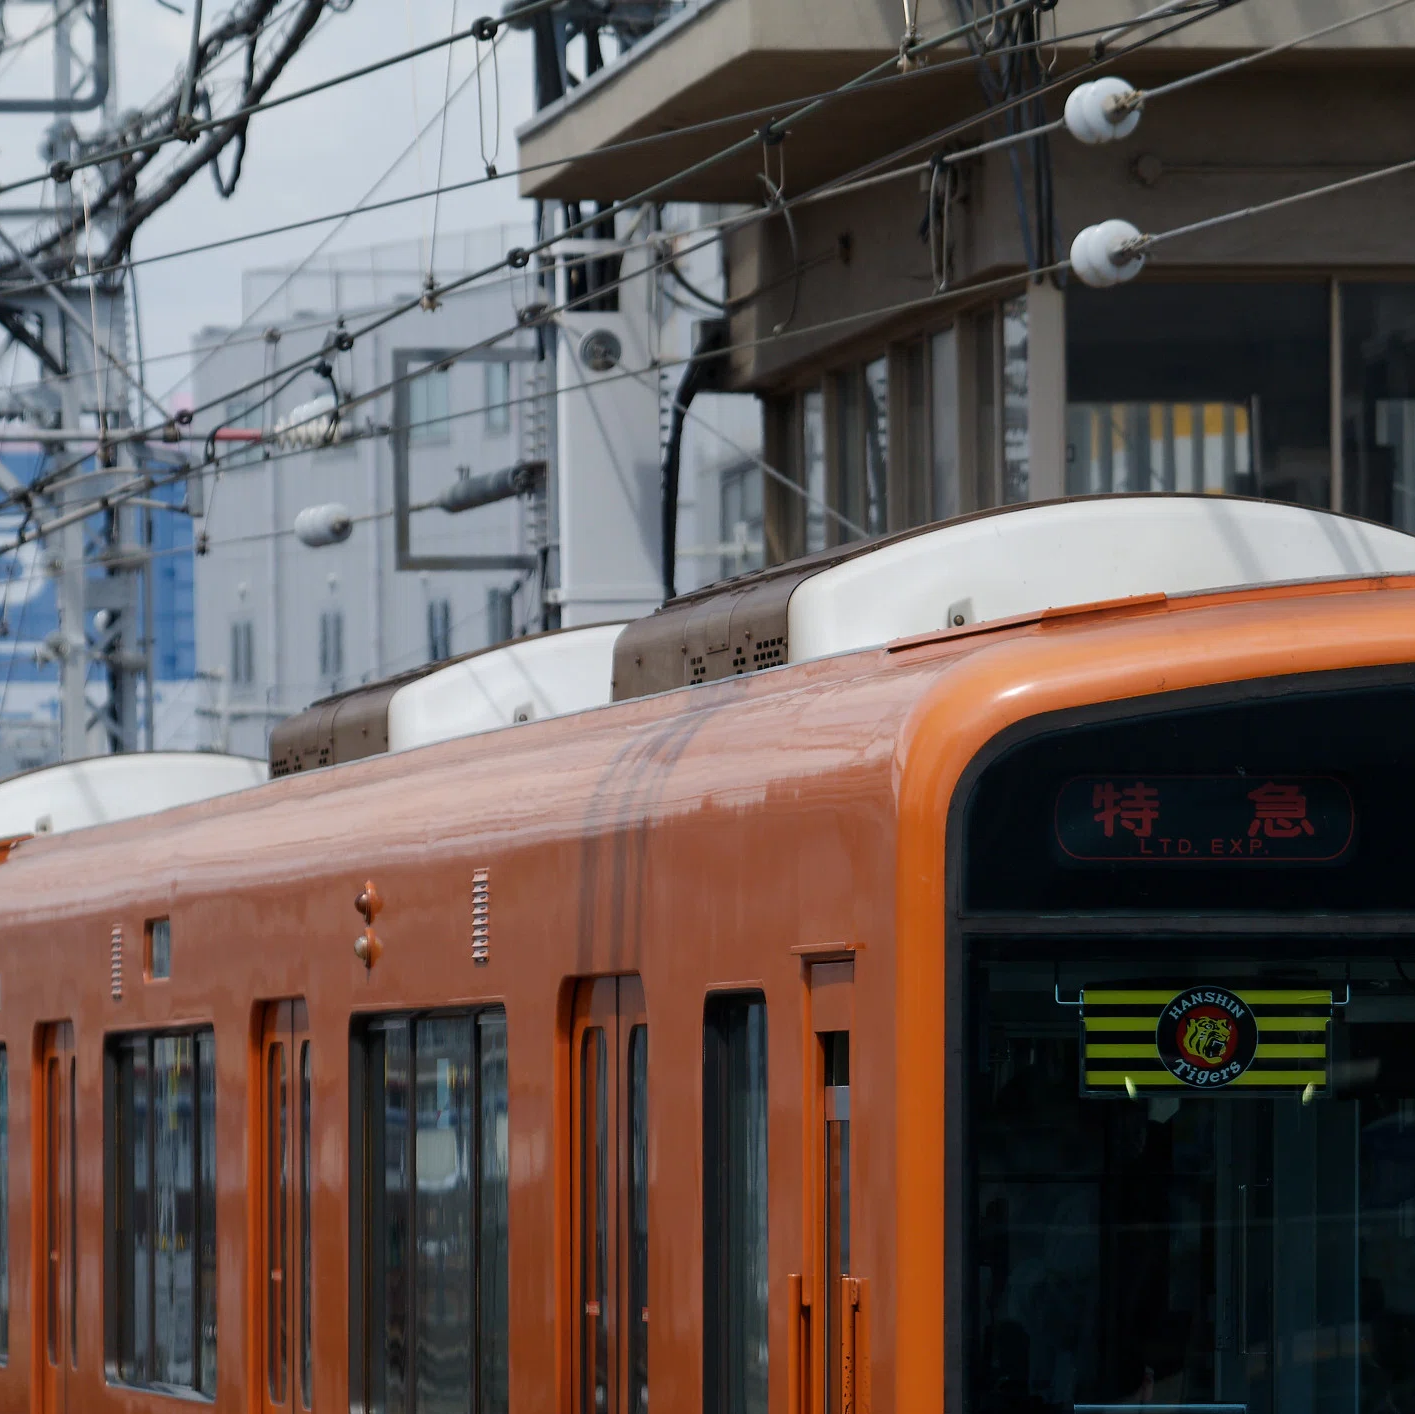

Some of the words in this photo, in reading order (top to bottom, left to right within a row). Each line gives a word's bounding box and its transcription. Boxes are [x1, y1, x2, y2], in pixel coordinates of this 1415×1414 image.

[1093, 782, 1315, 838] 特急
[1140, 838, 1200, 855] LTD.
[1211, 838, 1270, 855] EXP.
[1169, 992, 1246, 1020] HANSHIN
[1173, 1058, 1241, 1085] Tigers
